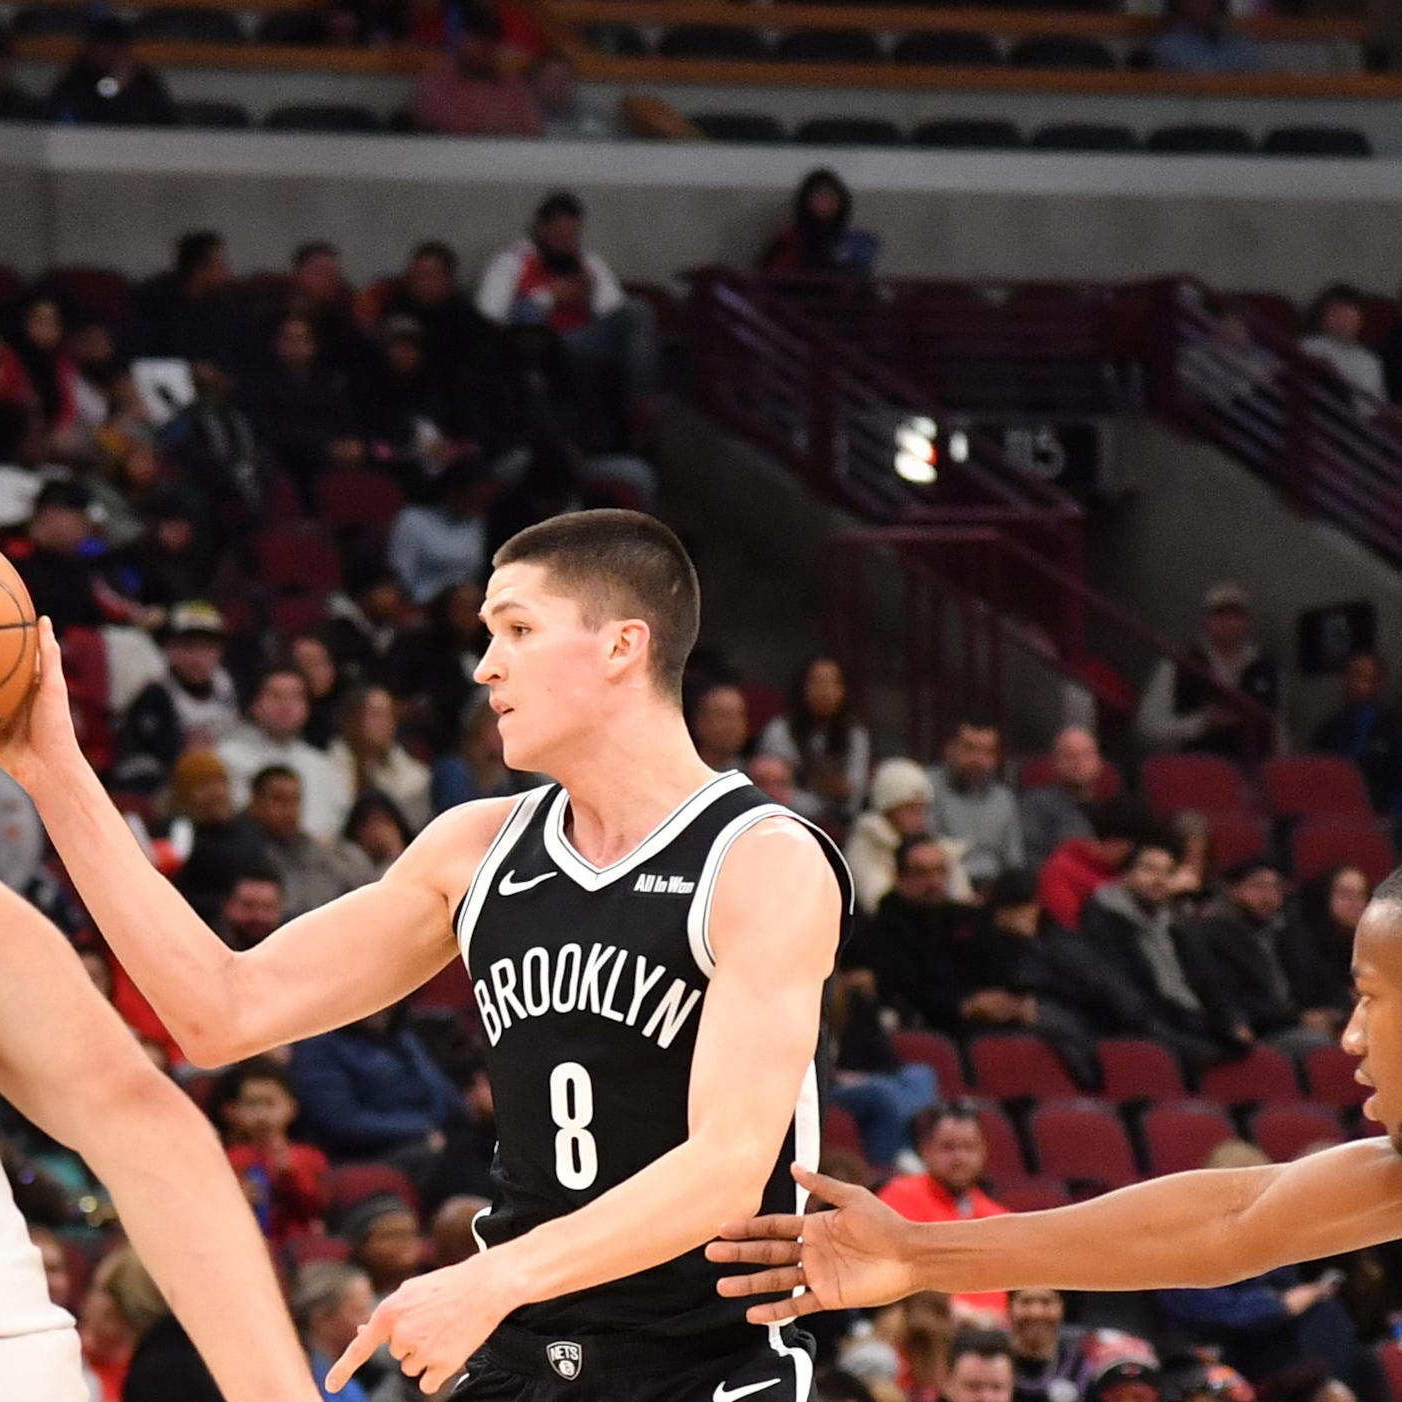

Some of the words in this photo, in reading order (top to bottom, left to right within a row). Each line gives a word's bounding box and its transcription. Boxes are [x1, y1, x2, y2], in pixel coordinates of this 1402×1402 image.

[633, 873, 656, 893] All
[473, 942, 701, 1050] BROOKLYN
[549, 1061, 598, 1191] 8
[550, 1345, 579, 1361] NETS
